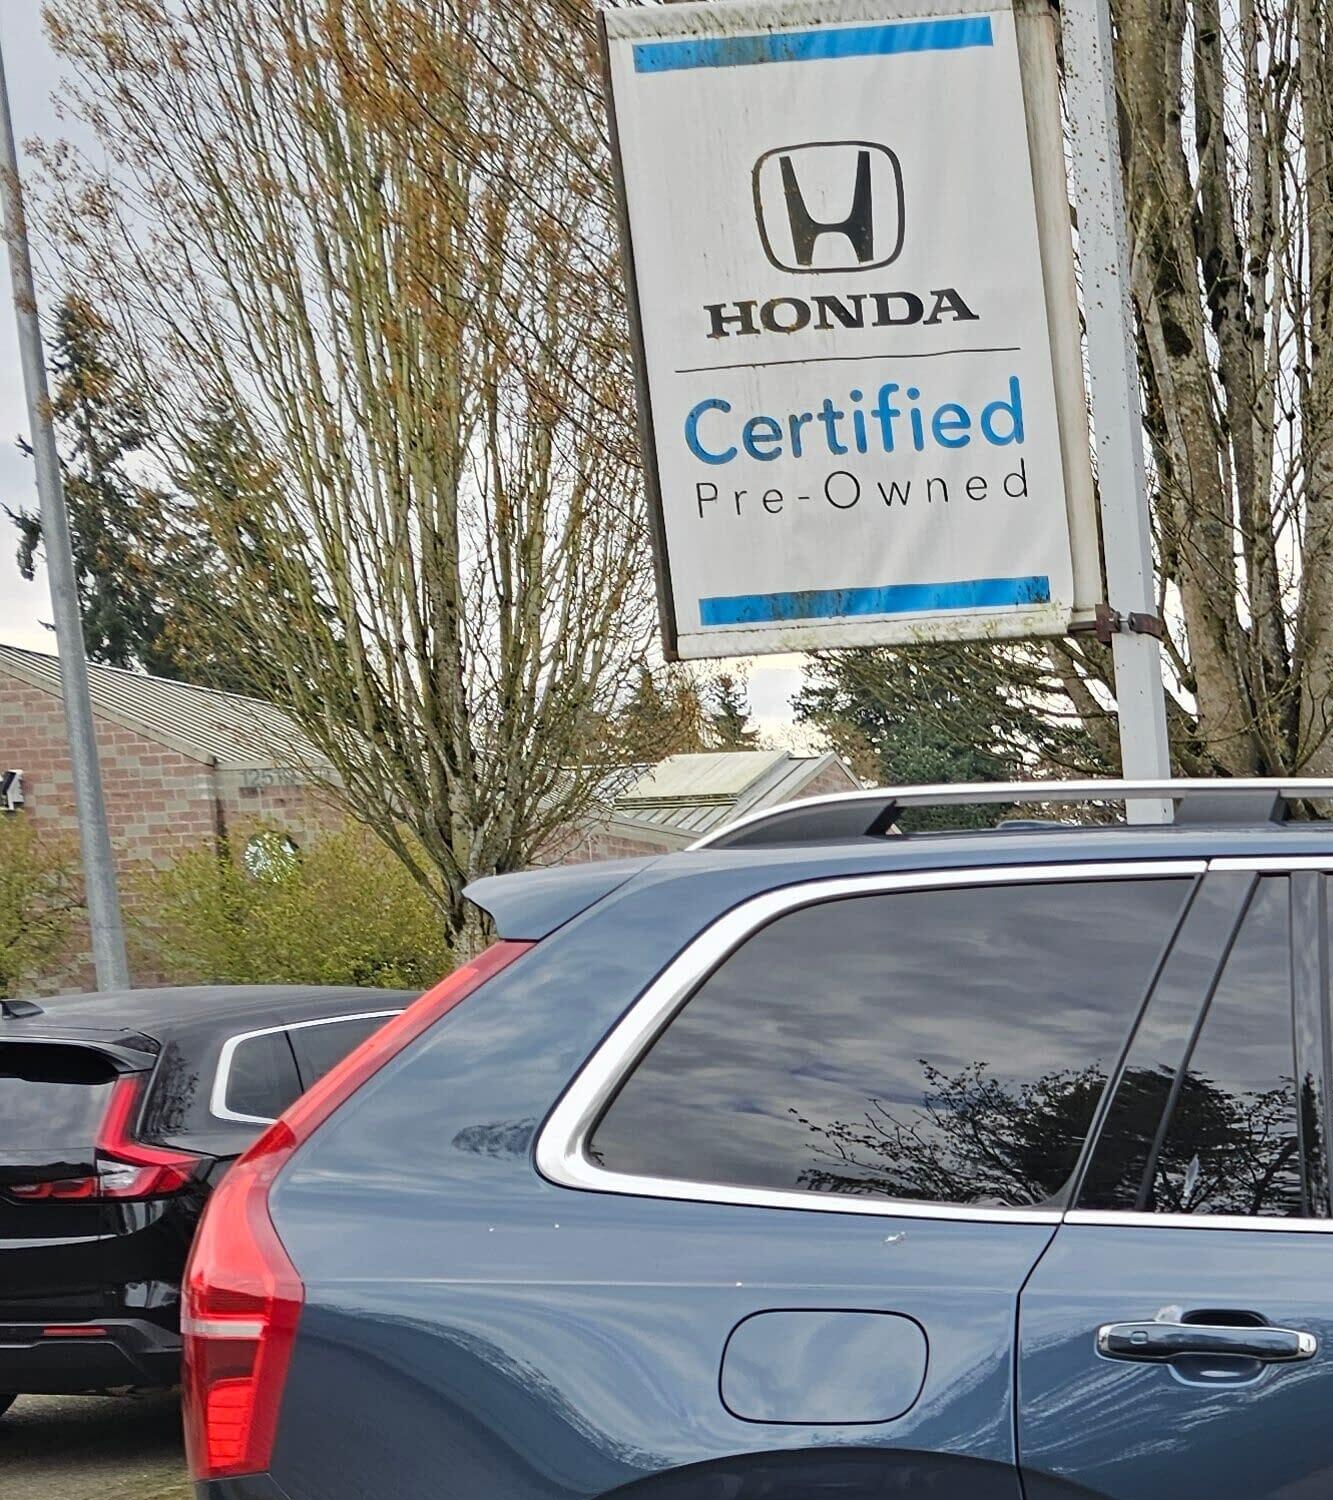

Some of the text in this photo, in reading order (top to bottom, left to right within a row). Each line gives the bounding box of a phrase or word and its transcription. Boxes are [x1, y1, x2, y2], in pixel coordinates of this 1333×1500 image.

[702, 288, 980, 339] HONDA
[684, 375, 1025, 466] Certified
[695, 458, 1029, 519] Pre-Owned
